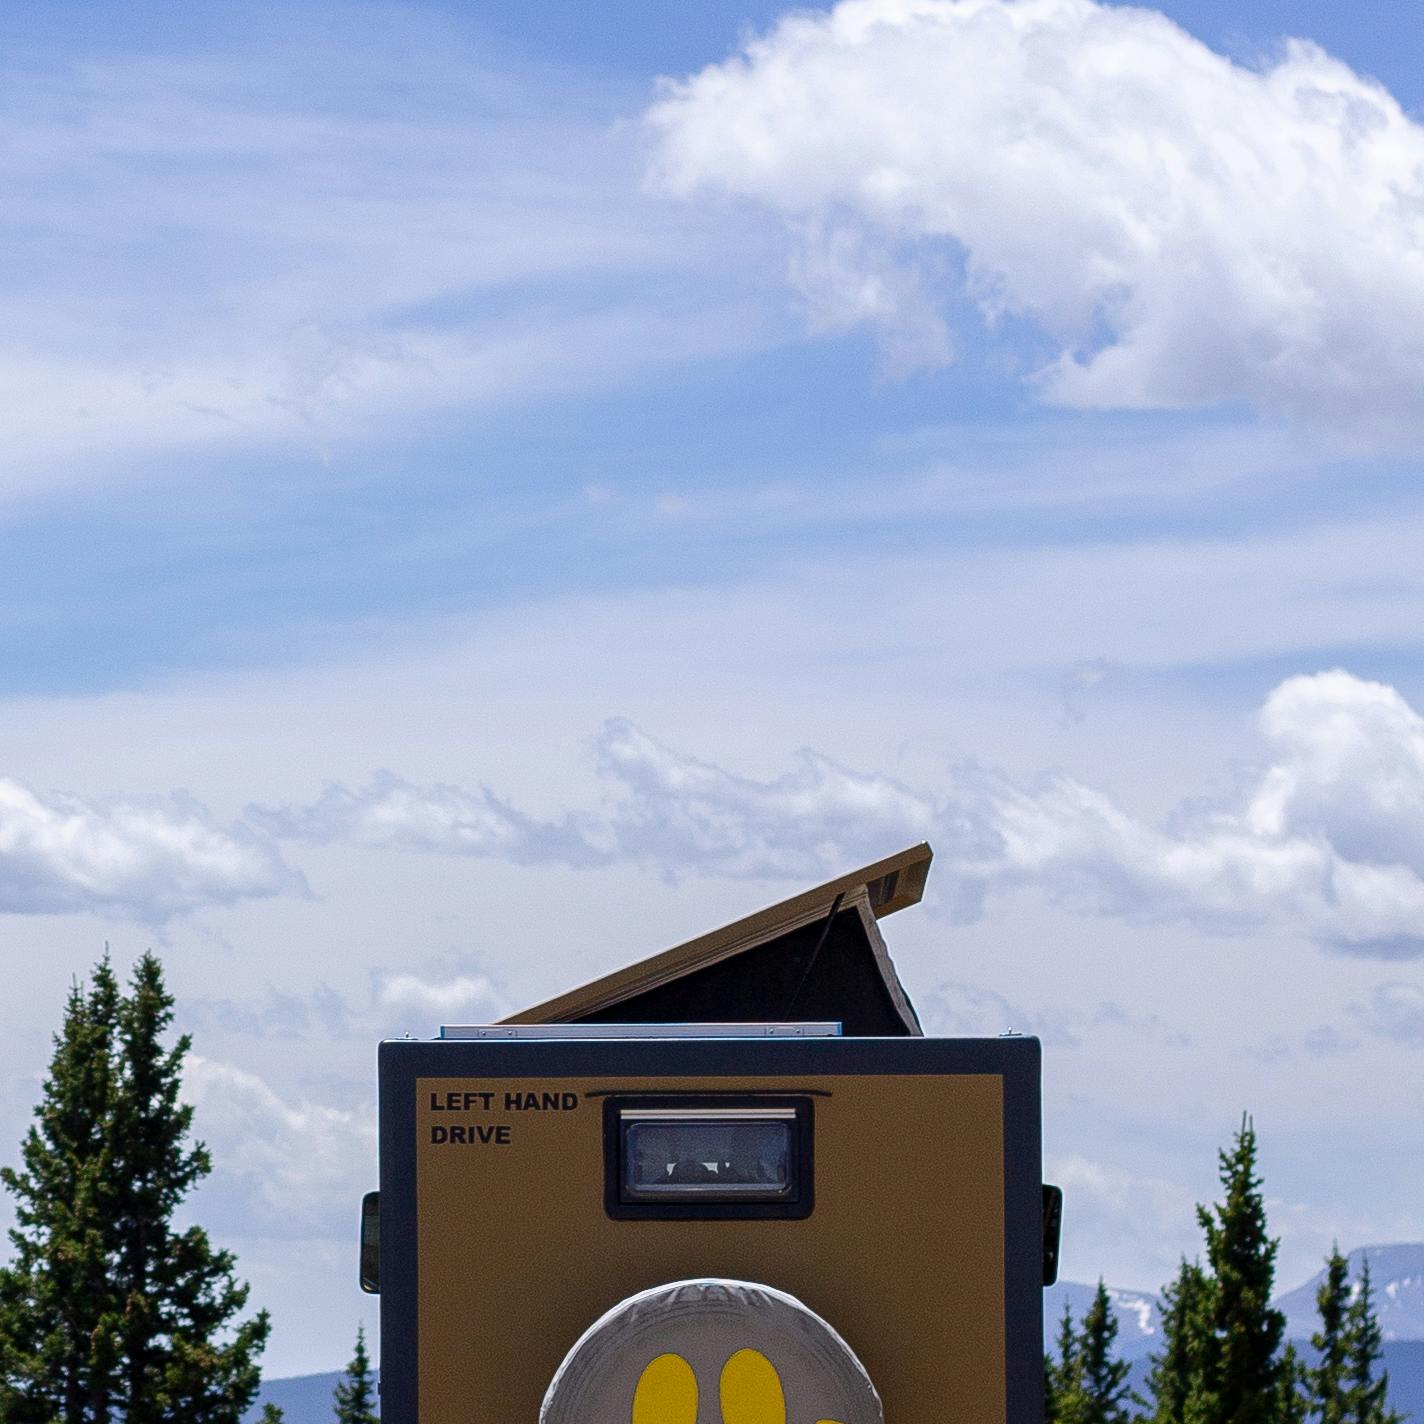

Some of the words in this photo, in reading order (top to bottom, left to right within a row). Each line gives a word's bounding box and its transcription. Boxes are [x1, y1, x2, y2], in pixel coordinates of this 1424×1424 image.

[430, 1092, 495, 1111] LEFT
[504, 1092, 578, 1111] HAND
[431, 1126, 511, 1144] DRIVE
